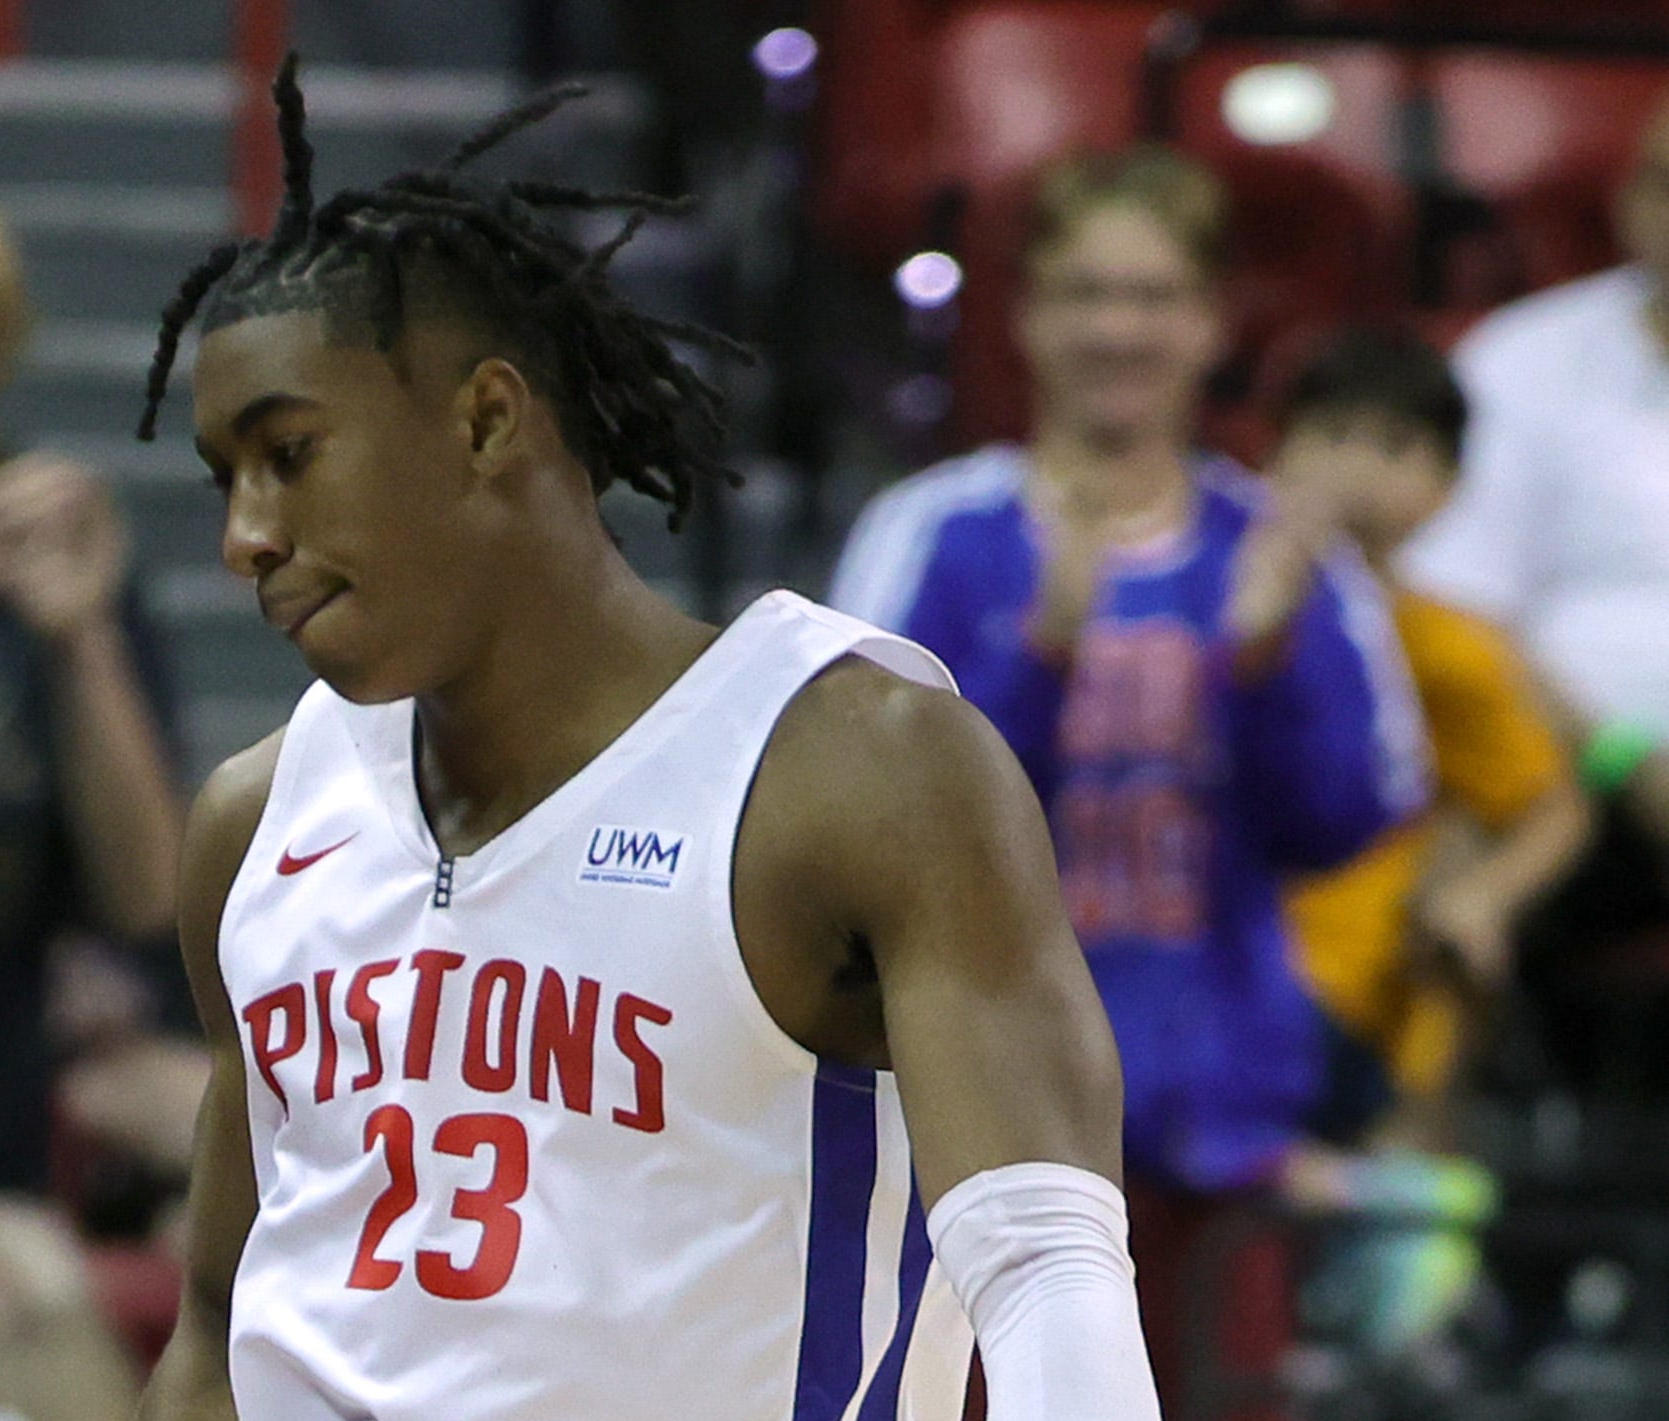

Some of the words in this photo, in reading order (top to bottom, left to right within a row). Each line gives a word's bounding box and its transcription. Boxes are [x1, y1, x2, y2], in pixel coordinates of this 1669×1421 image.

[588, 827, 684, 874] UWM
[242, 949, 673, 1133] PISTONS
[345, 1103, 529, 1301] 23
